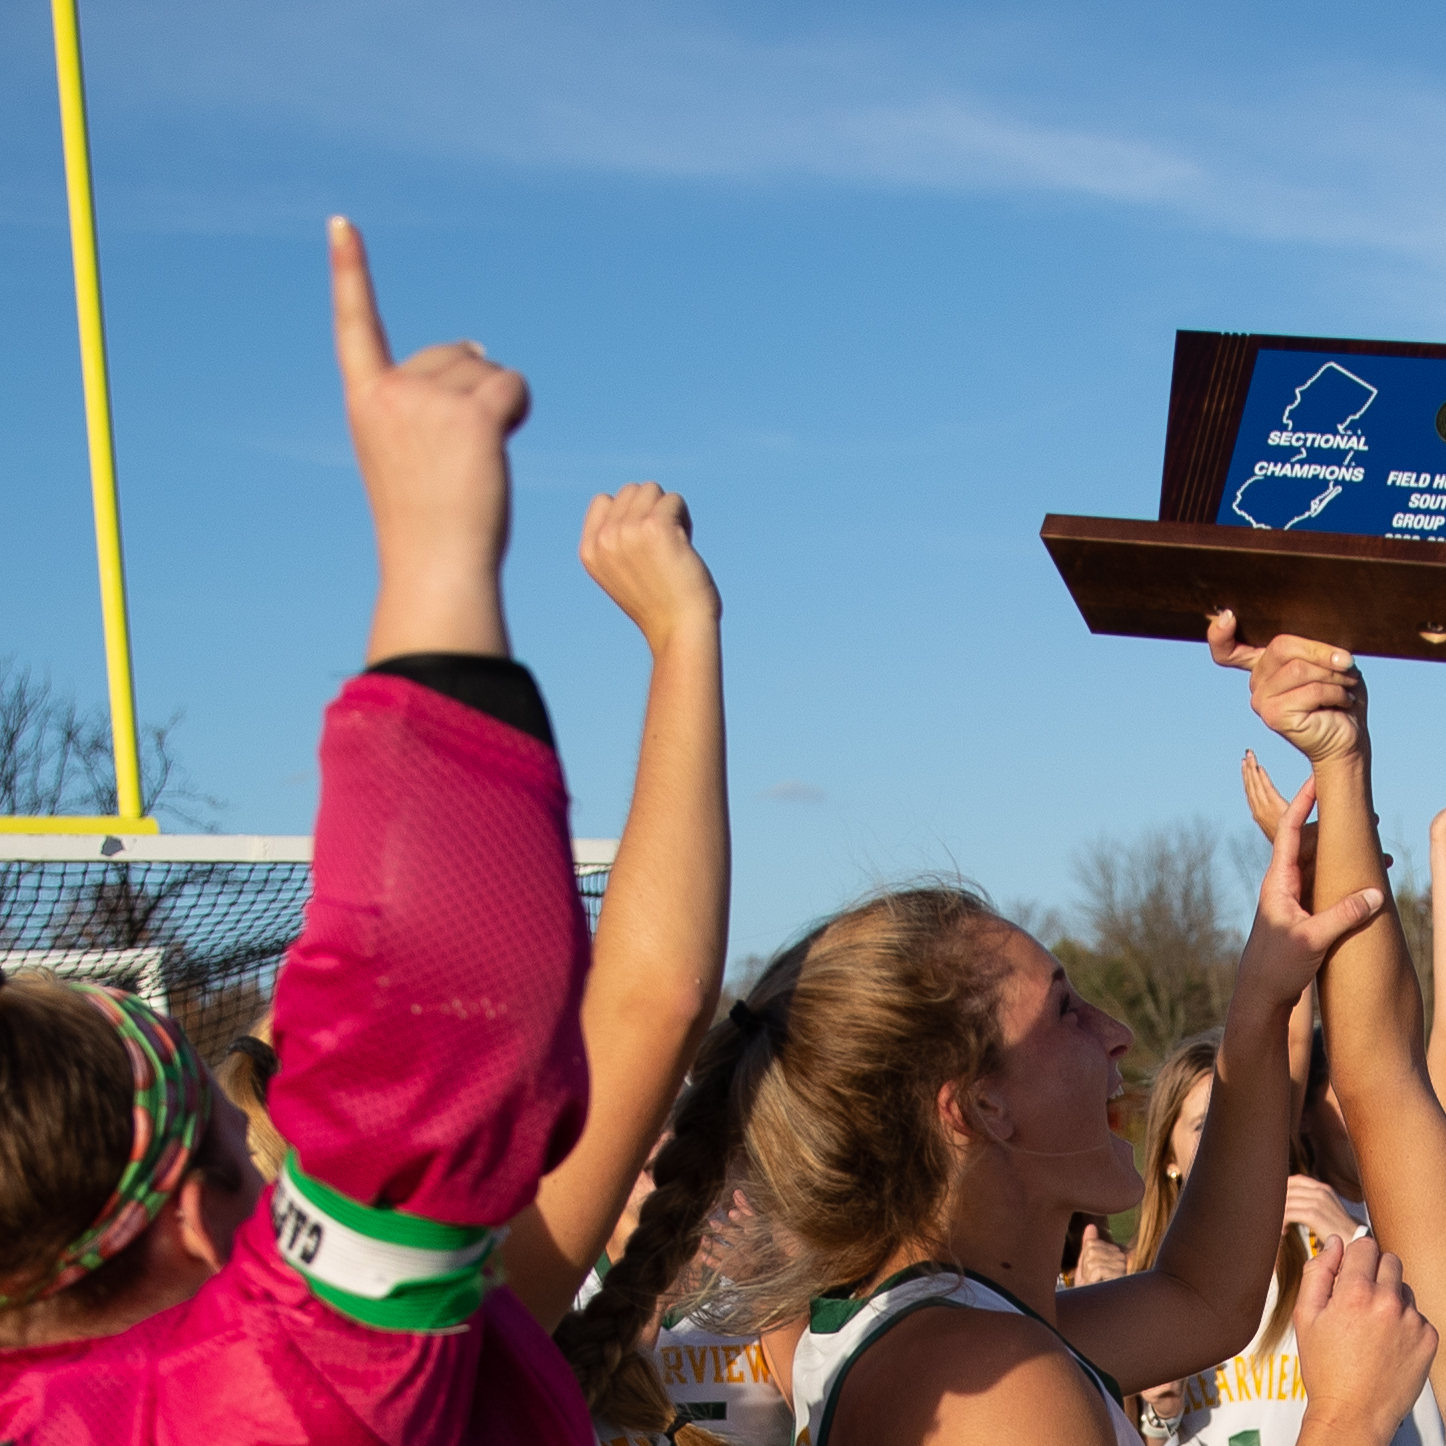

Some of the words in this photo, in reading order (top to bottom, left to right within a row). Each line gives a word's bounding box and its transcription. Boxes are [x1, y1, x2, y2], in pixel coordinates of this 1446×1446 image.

[1267, 430, 1369, 451] SECTIONAL
[1253, 461, 1365, 482] CHAMPIONS
[1386, 470, 1431, 489] FIELD
[1391, 512, 1446, 531] GROUP
